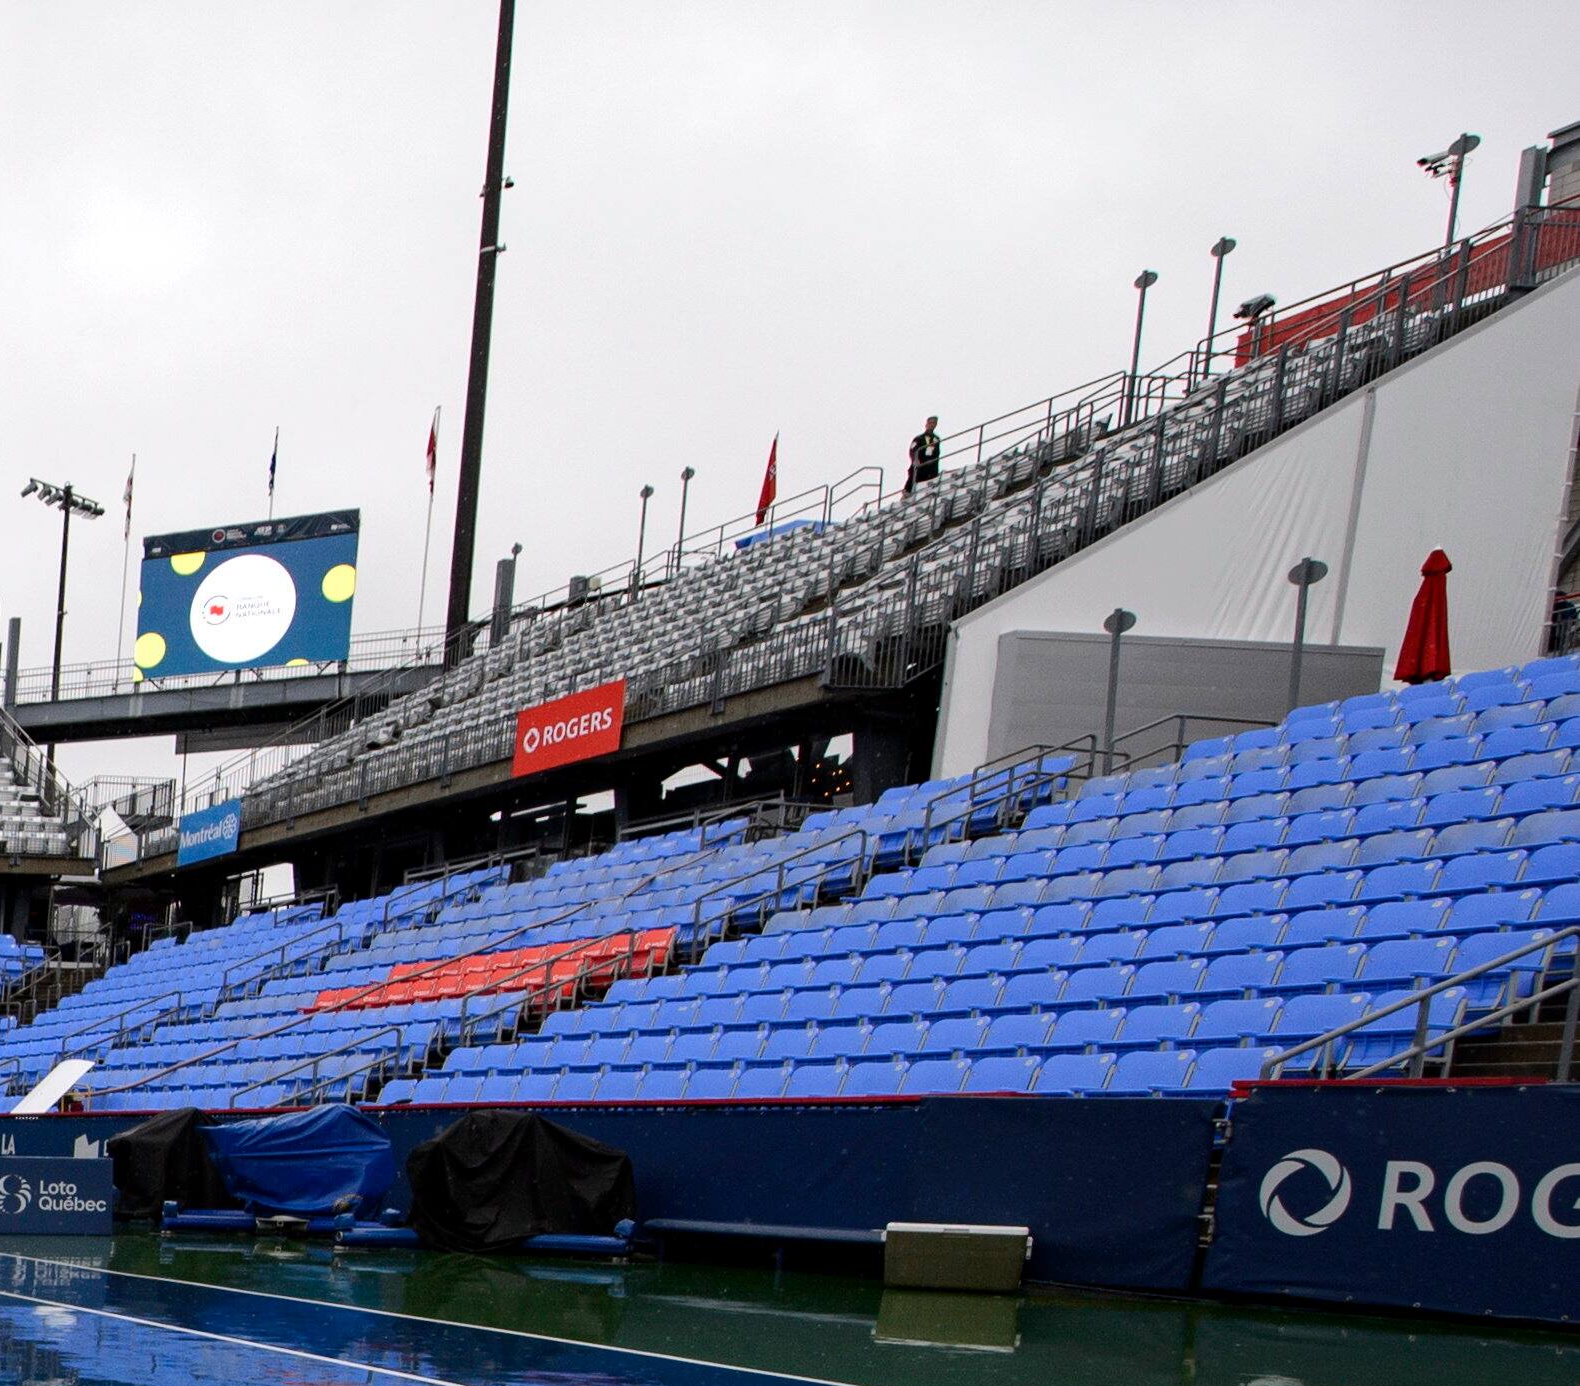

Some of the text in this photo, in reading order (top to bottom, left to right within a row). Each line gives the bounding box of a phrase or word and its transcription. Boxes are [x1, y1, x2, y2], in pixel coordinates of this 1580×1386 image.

[542, 707, 613, 746] ROGERS
[179, 821, 223, 848] Montréal
[39, 1181, 77, 1195] Loto
[39, 1196, 107, 1212] Québec
